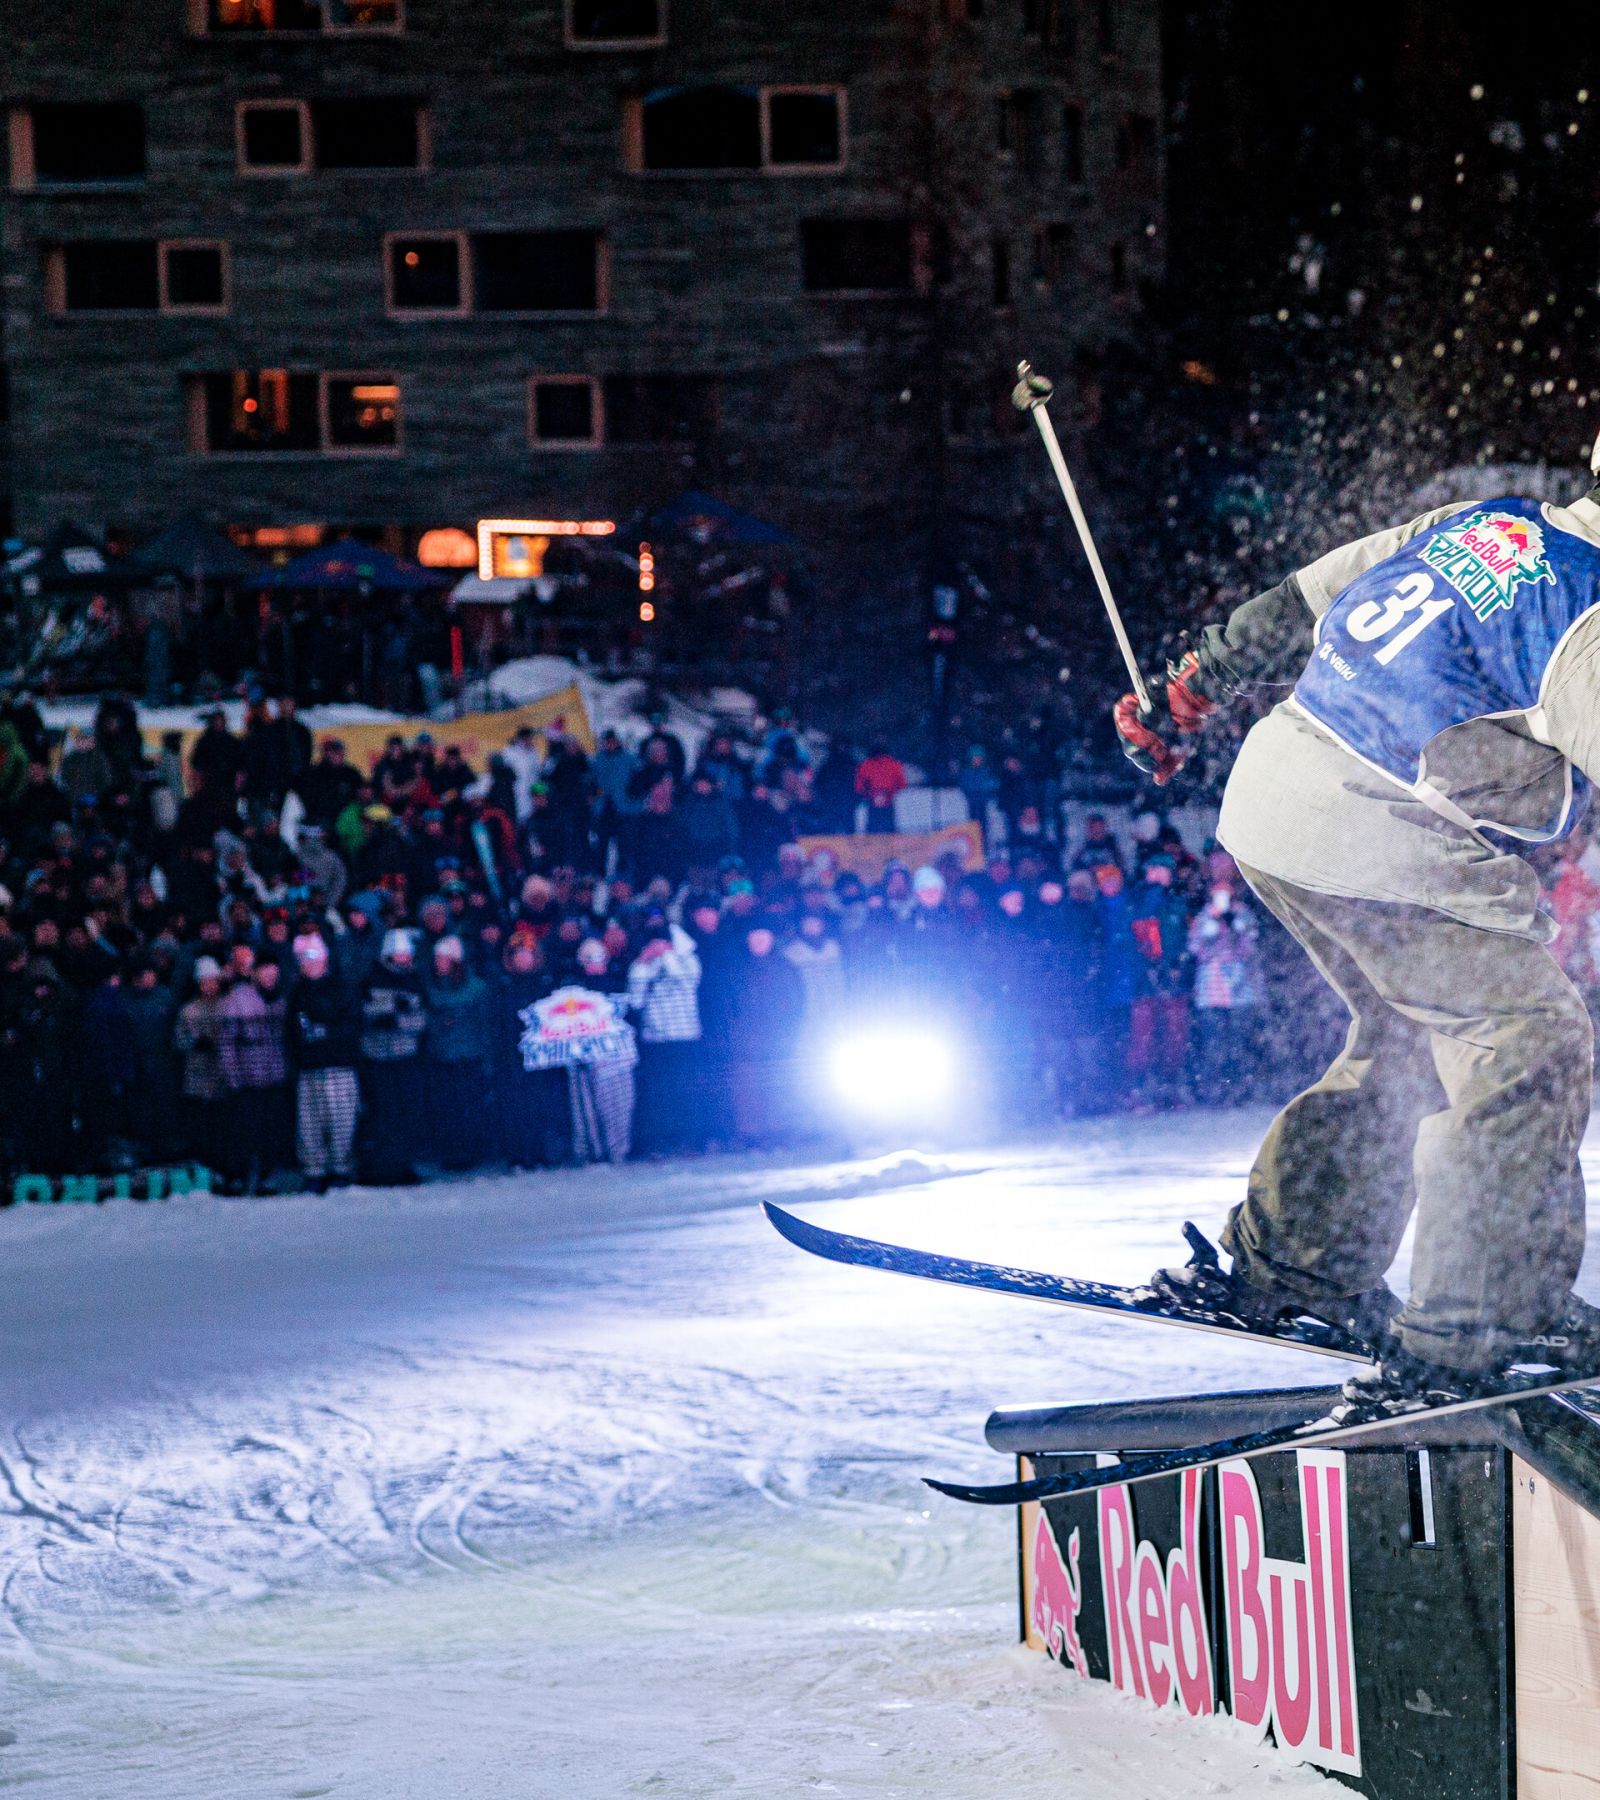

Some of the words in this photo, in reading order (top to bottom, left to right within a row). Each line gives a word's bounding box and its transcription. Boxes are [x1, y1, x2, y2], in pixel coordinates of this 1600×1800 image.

[1479, 538, 1517, 575] Bull
[1346, 572, 1455, 666] 31
[1101, 1470, 1212, 1717] Red
[1222, 1465, 1355, 1757] Bull
